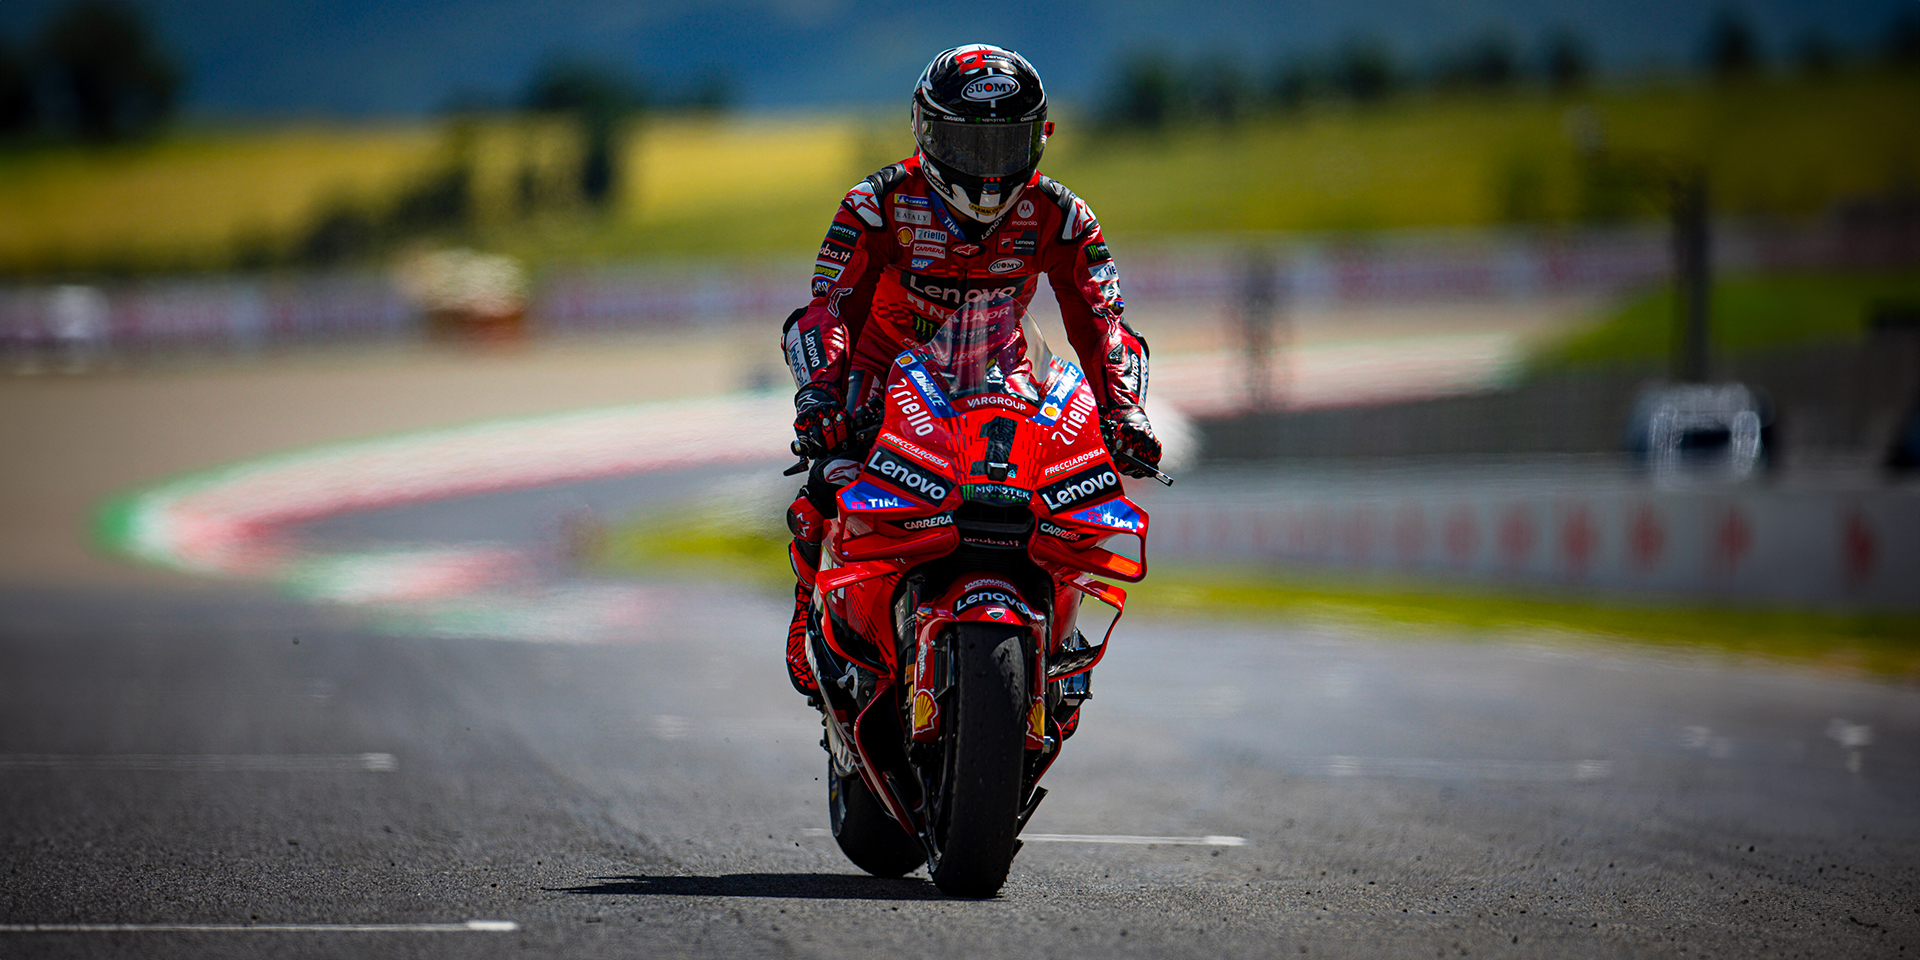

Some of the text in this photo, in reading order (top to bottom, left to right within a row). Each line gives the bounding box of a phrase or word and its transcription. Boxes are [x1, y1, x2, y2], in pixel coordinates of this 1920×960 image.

[967, 83, 1015, 94] SUOMY
[923, 229, 946, 242] riello
[944, 217, 959, 235] TIM
[914, 245, 945, 255] CARRERA
[911, 260, 928, 268] SAP
[909, 275, 1017, 303] Lenovo
[805, 329, 820, 368] Lenovo
[892, 390, 934, 437] riello
[966, 396, 1027, 412] VARGROUP
[1062, 392, 1097, 437] riello
[882, 432, 949, 469] FRECCIAROSSA
[969, 415, 1019, 478] 1
[1044, 447, 1106, 476] FRECCIAROSSA
[868, 451, 946, 500] Lenovo
[975, 484, 1031, 501] MONSTER
[1042, 471, 1117, 511] Lenovo
[868, 497, 899, 508] TIM
[904, 514, 953, 531] CARRERA
[963, 537, 1020, 547] aruba.it
[1040, 523, 1081, 542] CARRERA
[956, 591, 1029, 615] Lenovo
